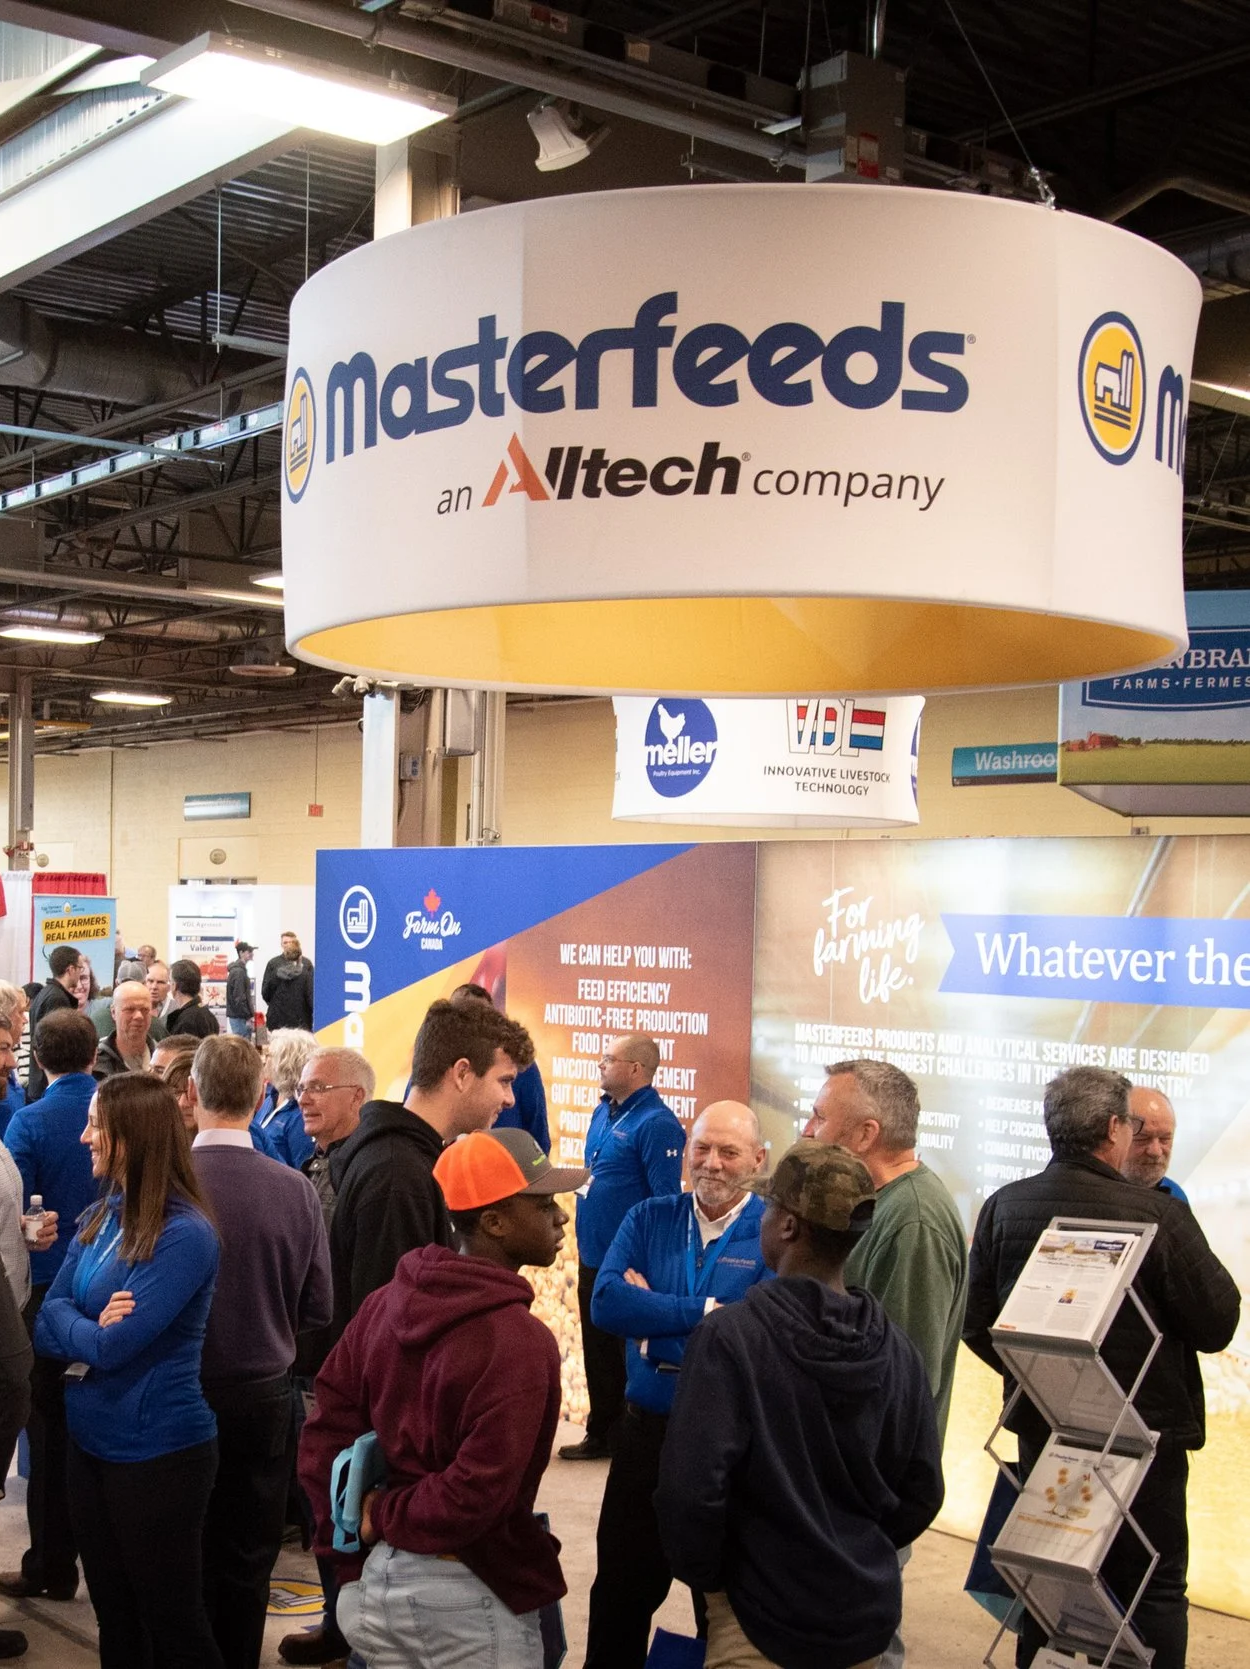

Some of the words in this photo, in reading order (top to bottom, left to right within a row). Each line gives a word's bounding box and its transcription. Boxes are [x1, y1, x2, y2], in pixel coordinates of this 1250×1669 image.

[436, 485, 473, 515] an
[481, 431, 742, 508] Alltech
[753, 467, 945, 512] company
[1113, 677, 1170, 689] FARMS
[644, 735, 718, 766] meller
[975, 751, 1057, 771] Washroo
[763, 766, 836, 779] INNOVATIVE
[840, 769, 890, 783] LIVESTOCK
[795, 781, 869, 796] TECHNOLOGY
[44, 921, 65, 930] REAL
[402, 910, 440, 939] Farm
[440, 911, 461, 937] On
[821, 886, 875, 940] For
[45, 932, 66, 942] REAL
[421, 937, 443, 950] CANADA
[814, 912, 925, 977] farming
[560, 943, 577, 965] WE
[579, 944, 601, 966] CAN
[603, 944, 632, 967] HELP
[634, 945, 656, 968] YOU
[658, 946, 692, 970] WITH:
[975, 932, 1176, 983] Whatever
[578, 979, 605, 1001] FEED
[607, 980, 671, 1005] EFFICIENCY
[544, 1003, 634, 1030] ANTIBIOTIC-FREE
[636, 1009, 708, 1036] PRODUCTION
[572, 1032, 600, 1054] FOOD
[795, 1023, 873, 1048] MASTERFEEDS
[875, 1027, 935, 1052] PRODUCTS
[936, 1033, 962, 1054] AND
[964, 1035, 1039, 1062] ANALYTICAL
[1042, 1042, 1106, 1067] SERVICES
[1108, 1046, 1137, 1069] ARE
[1139, 1050, 1210, 1075] DESIGNED
[795, 1044, 809, 1063] TO
[937, 1055, 1014, 1083] CHALLENGES
[1017, 1063, 1031, 1084] IN
[551, 1083, 573, 1105] GUT
[574, 1085, 602, 1107] HEAL
[920, 1132, 955, 1150] QUALITY
[984, 1140, 1021, 1159] COMBAT
